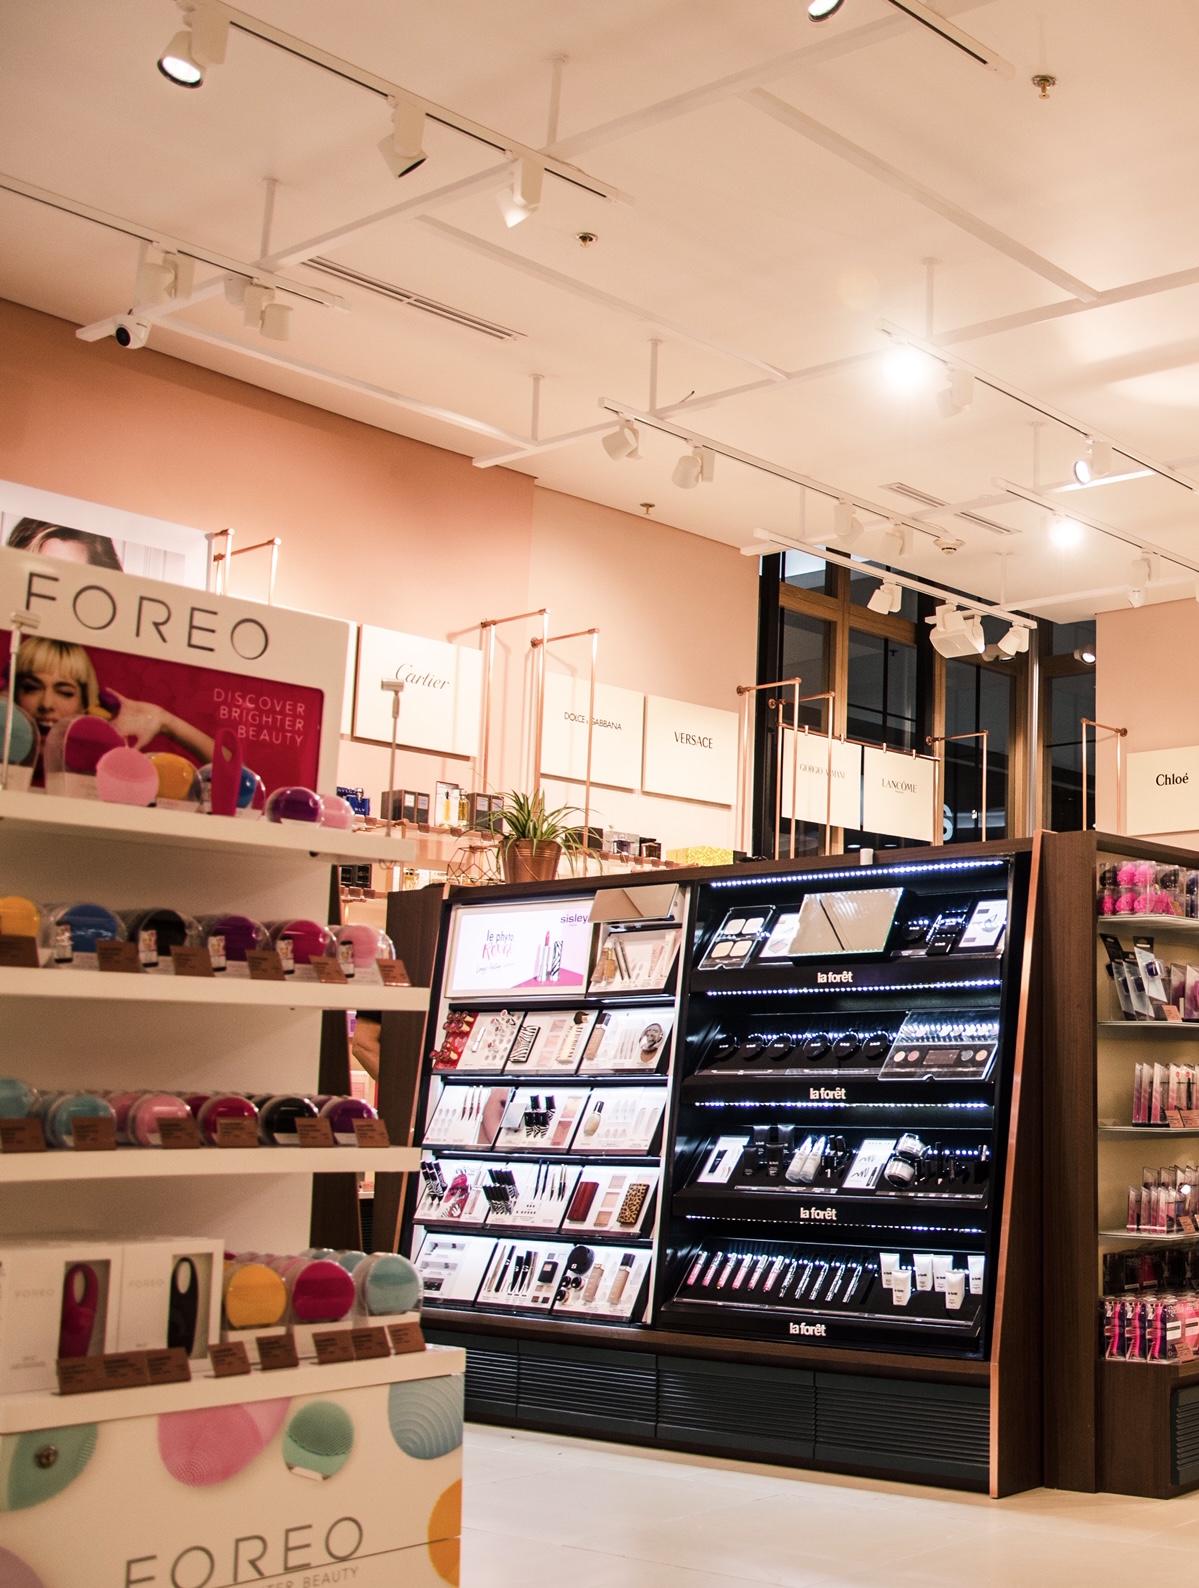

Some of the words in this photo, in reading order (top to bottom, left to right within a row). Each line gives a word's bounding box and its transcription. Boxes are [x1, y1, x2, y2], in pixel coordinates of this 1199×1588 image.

[24, 571, 270, 660] FOREO
[395, 663, 450, 690] Cartier
[213, 688, 305, 716] DISCOVER
[219, 705, 305, 732] BRIGHTER
[237, 725, 304, 747] BEAUTY
[674, 731, 714, 749] VERSACE
[825, 767, 846, 780] AMANI
[1155, 772, 1190, 787] Chloé
[881, 778, 918, 794] LANCÔME
[560, 914, 589, 924] sisley
[486, 929, 494, 942] le
[818, 972, 827, 983] la
[827, 970, 853, 983] forêt
[810, 1088, 819, 1100] la
[820, 1087, 846, 1100] forêt
[800, 1207, 809, 1218] la
[810, 1207, 837, 1220] forêt
[790, 1322, 799, 1334] la
[800, 1322, 826, 1336] forêt
[125, 1516, 363, 1588] FOREO
[302, 1566, 359, 1588] BEAUTY
